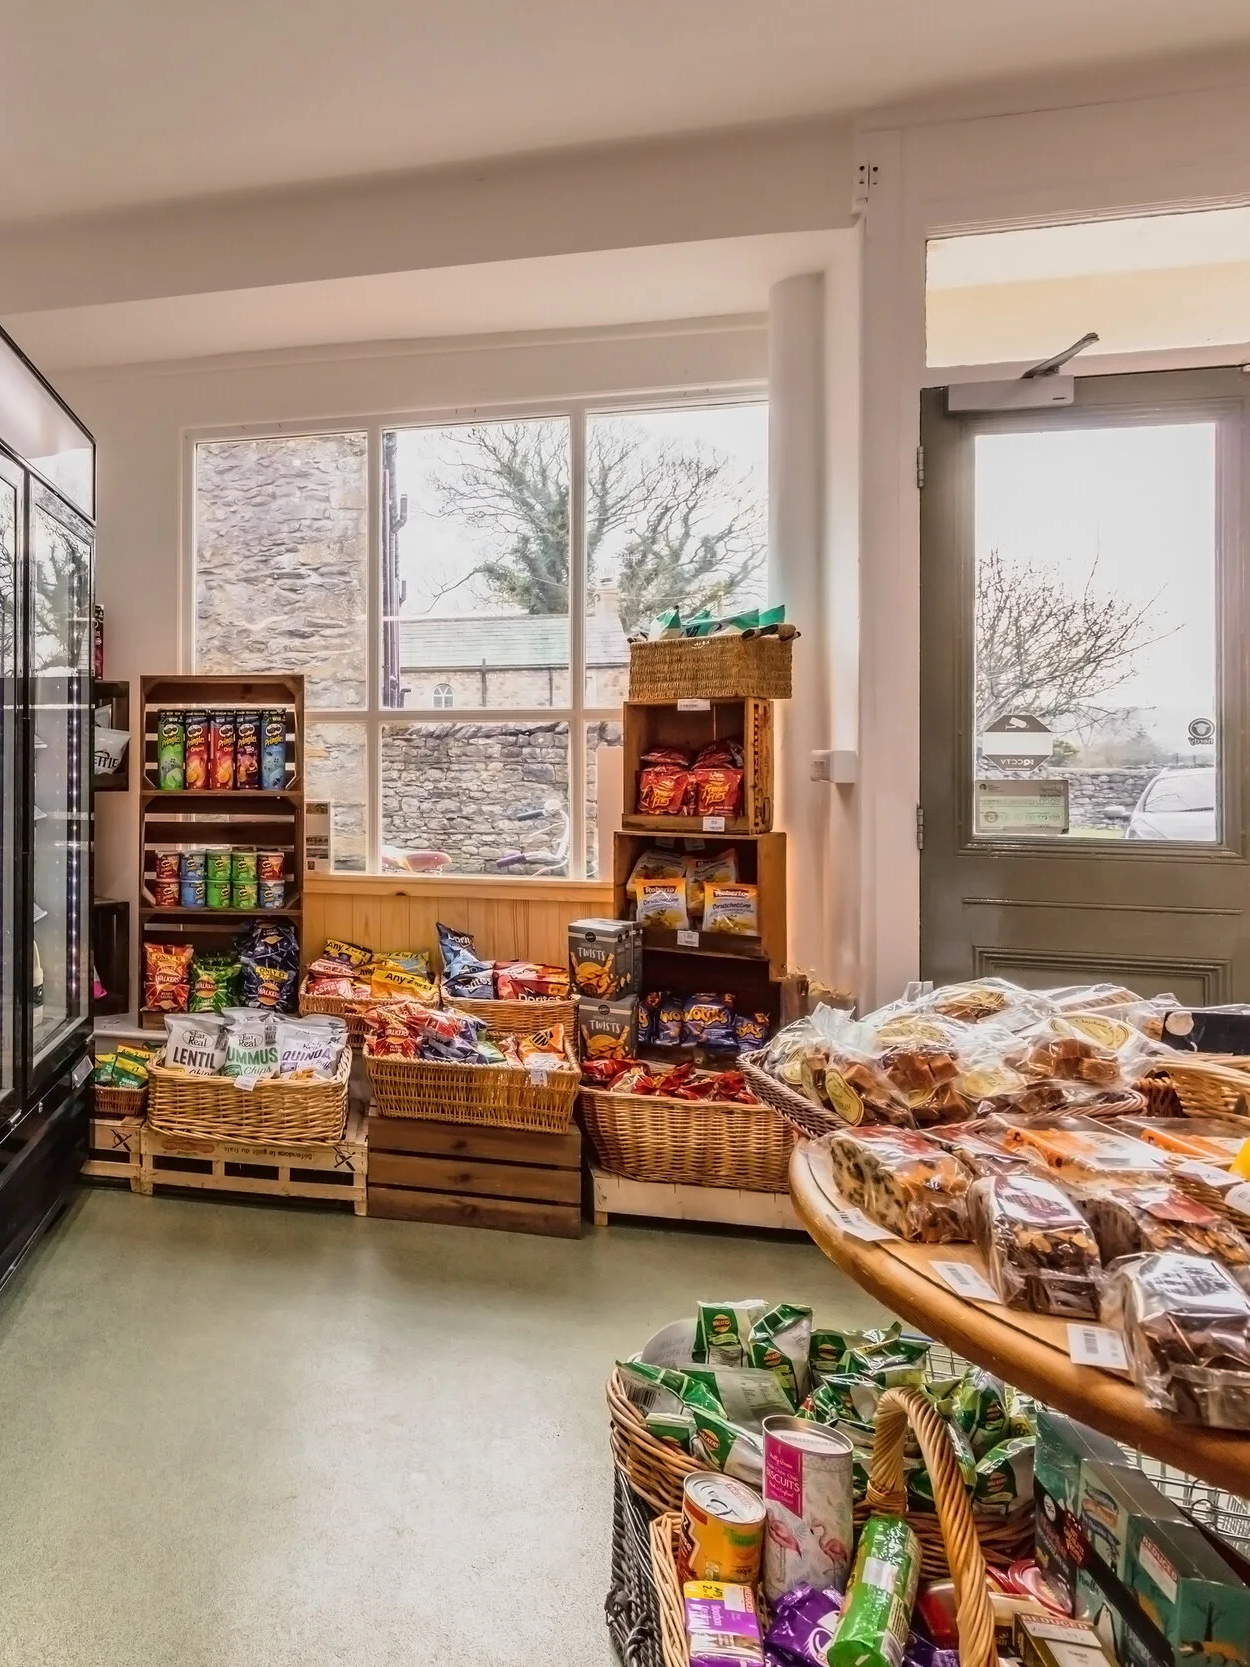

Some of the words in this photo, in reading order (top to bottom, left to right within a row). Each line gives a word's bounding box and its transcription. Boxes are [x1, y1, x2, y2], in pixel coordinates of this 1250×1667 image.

[94, 758, 118, 769] ETTLE
[326, 941, 344, 951] Any
[576, 946, 606, 961] TWISTS
[259, 967, 278, 976] ONLY
[154, 975, 182, 984] WALKERS
[384, 972, 405, 985] Any
[408, 976, 415, 984] 2
[257, 988, 280, 999] WALKERS
[588, 1020, 621, 1034] TWISTS
[193, 1030, 206, 1039] Eat
[242, 1032, 254, 1041] Eat
[188, 1037, 207, 1047] Real
[238, 1038, 258, 1048] Real
[172, 1046, 216, 1070] LENTIL
[226, 1046, 279, 1066] UMMUS
[282, 1047, 332, 1061] QUINOA
[243, 1066, 272, 1076] Chips
[1143, 1535, 1178, 1582] REDUCED
[1021, 1614, 1089, 1630] REDUCED
